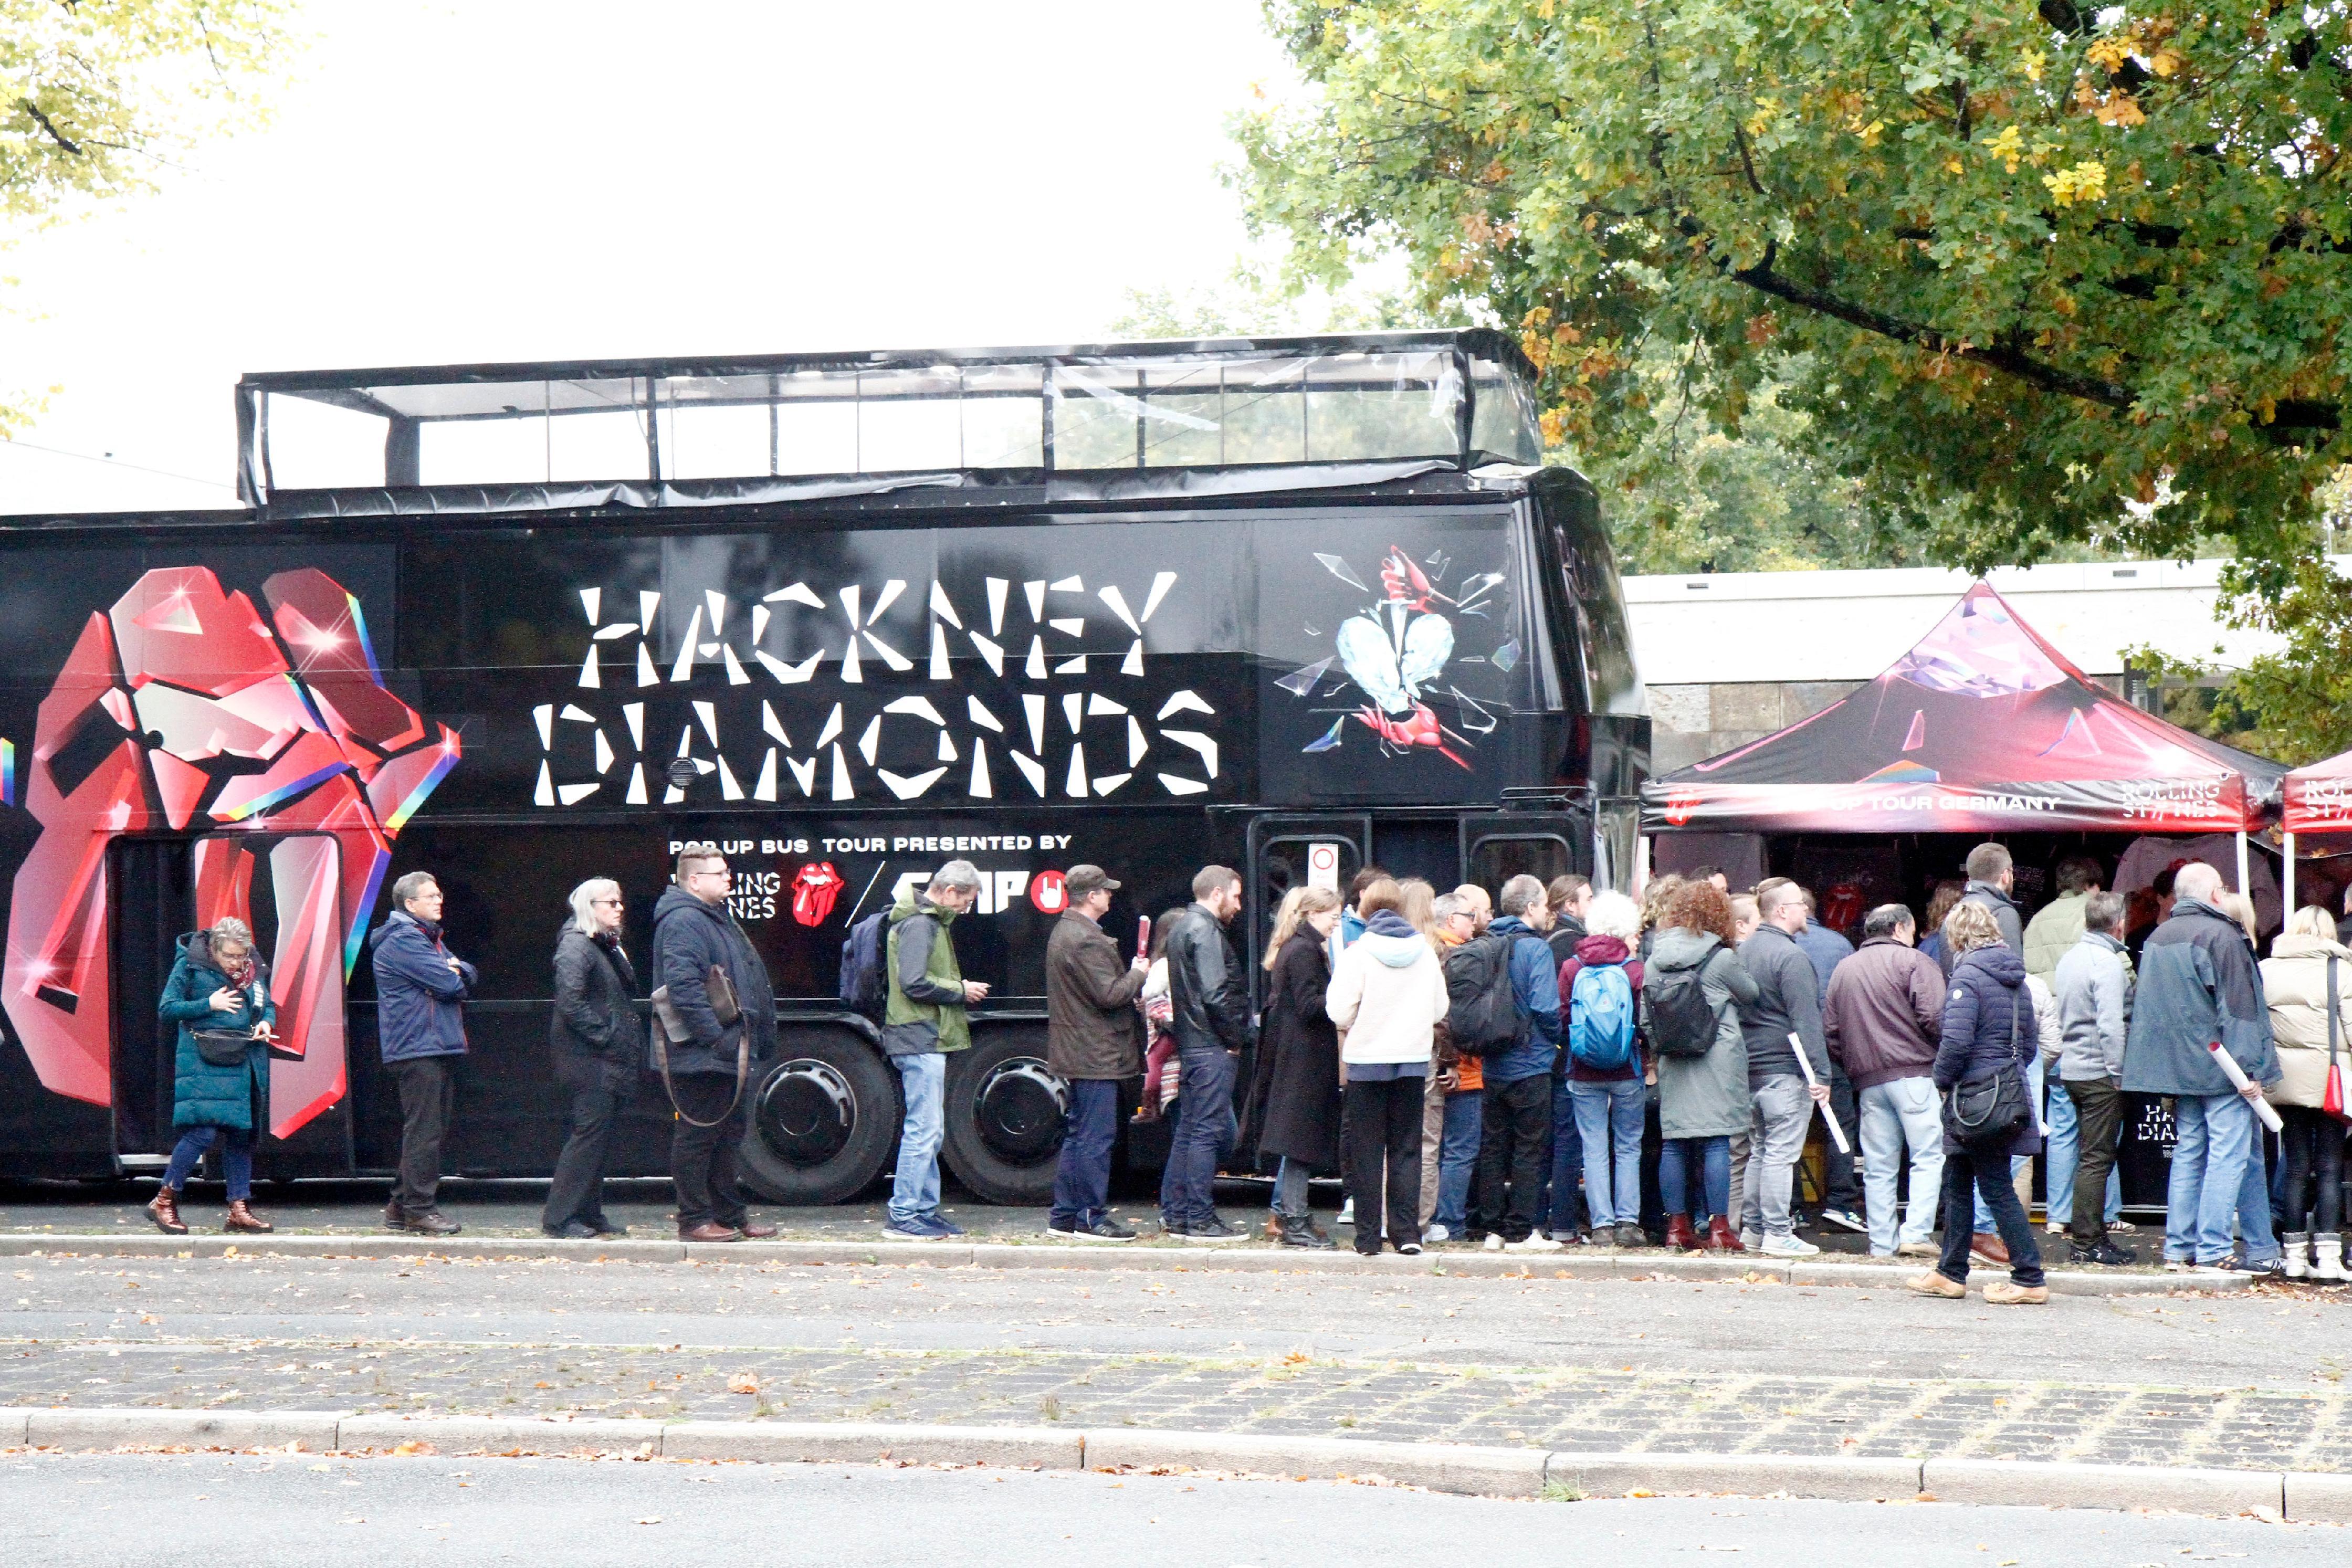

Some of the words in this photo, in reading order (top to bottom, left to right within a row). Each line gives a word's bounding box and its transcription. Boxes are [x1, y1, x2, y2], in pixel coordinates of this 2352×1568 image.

[578, 571, 1177, 688] HACKNEY
[532, 689, 1218, 806] DIAMONDS
[2121, 780, 2220, 801] ROLLING
[1868, 796, 1933, 811] TOUR
[1938, 796, 2061, 811] GERMANY
[723, 840, 754, 855] UP
[762, 839, 808, 854] BUS
[822, 837, 886, 853] TOUR
[894, 836, 1032, 852] PRESENTED
[1040, 835, 1072, 850] BY
